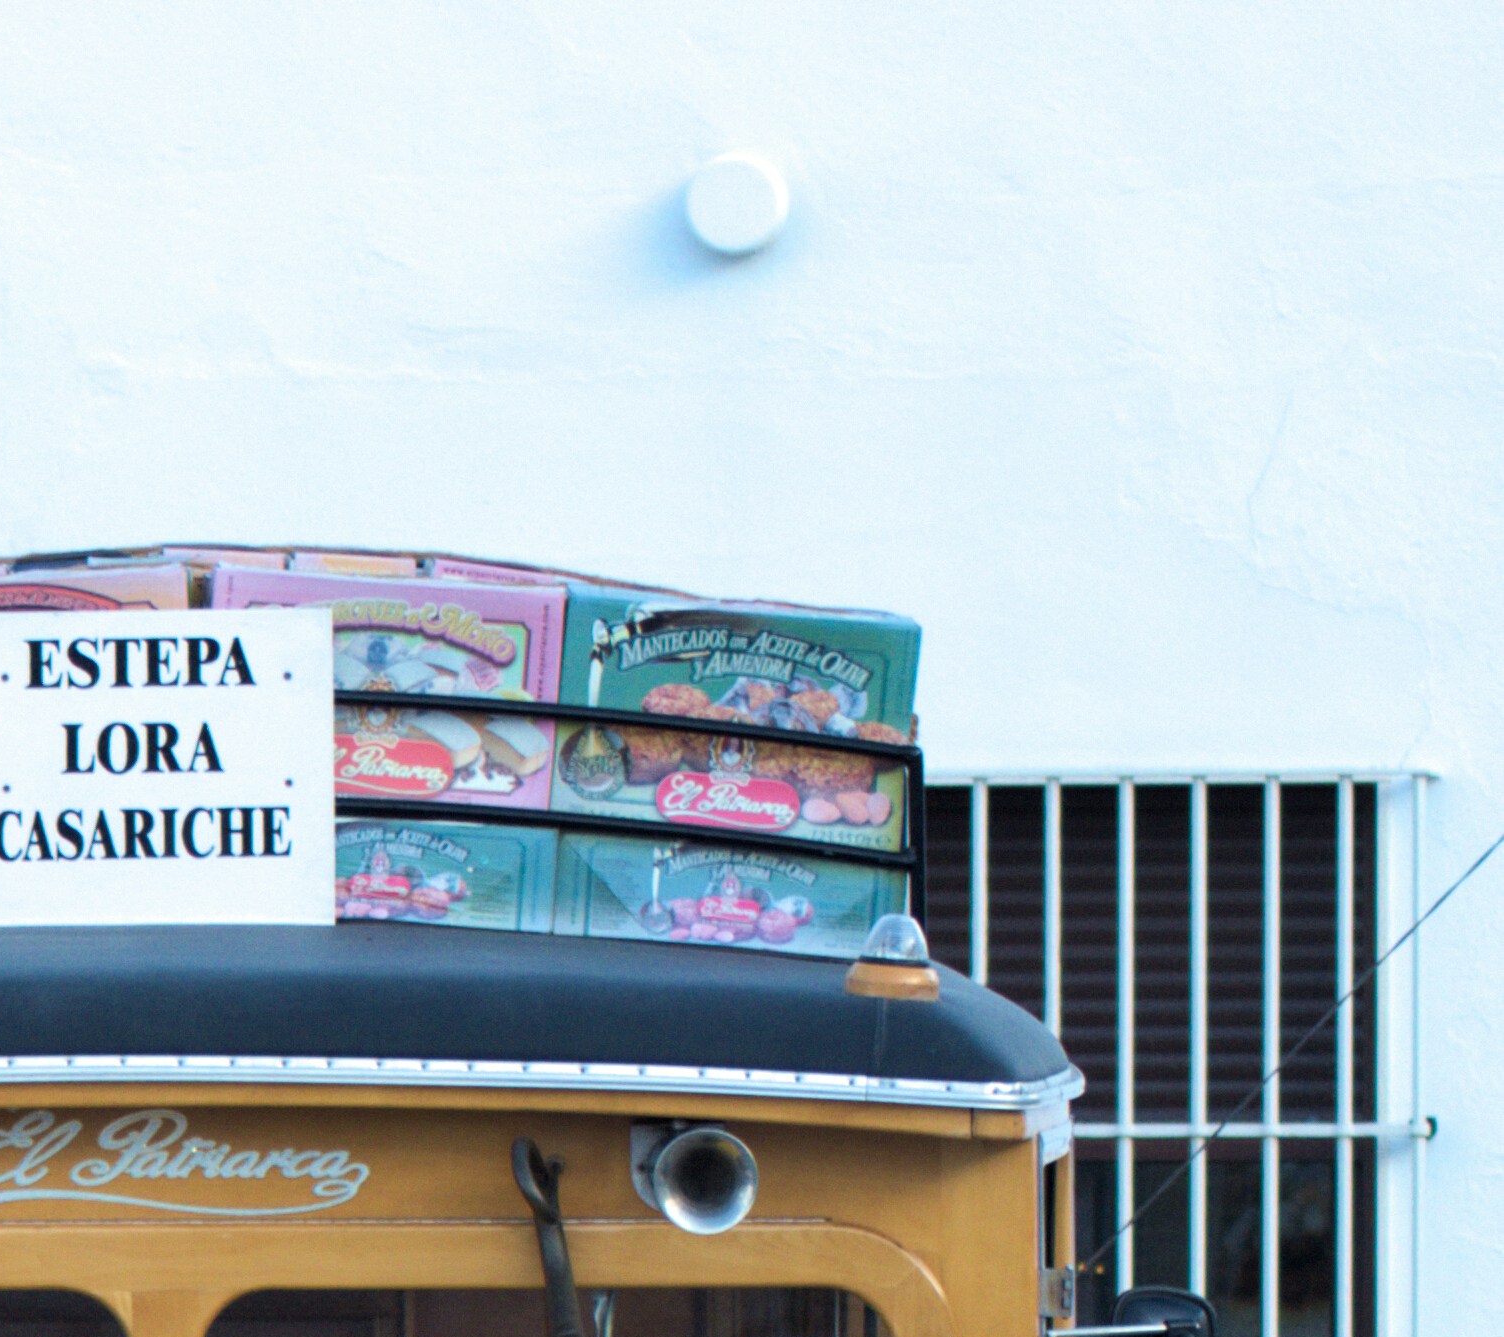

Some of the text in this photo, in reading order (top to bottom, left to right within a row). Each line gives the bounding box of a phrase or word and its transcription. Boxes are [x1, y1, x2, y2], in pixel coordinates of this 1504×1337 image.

[24, 636, 257, 689] ESTEPA
[620, 629, 729, 671] MANTECADOS
[748, 631, 806, 662] ACEITE
[820, 651, 872, 690] OLIVA
[701, 652, 793, 682] ALMENDRA
[61, 721, 225, 775] LORA
[341, 745, 449, 791] Patriarca
[663, 774, 704, 811] El
[696, 784, 796, 825] Patriarca
[69, 1109, 370, 1197] Patriarca
